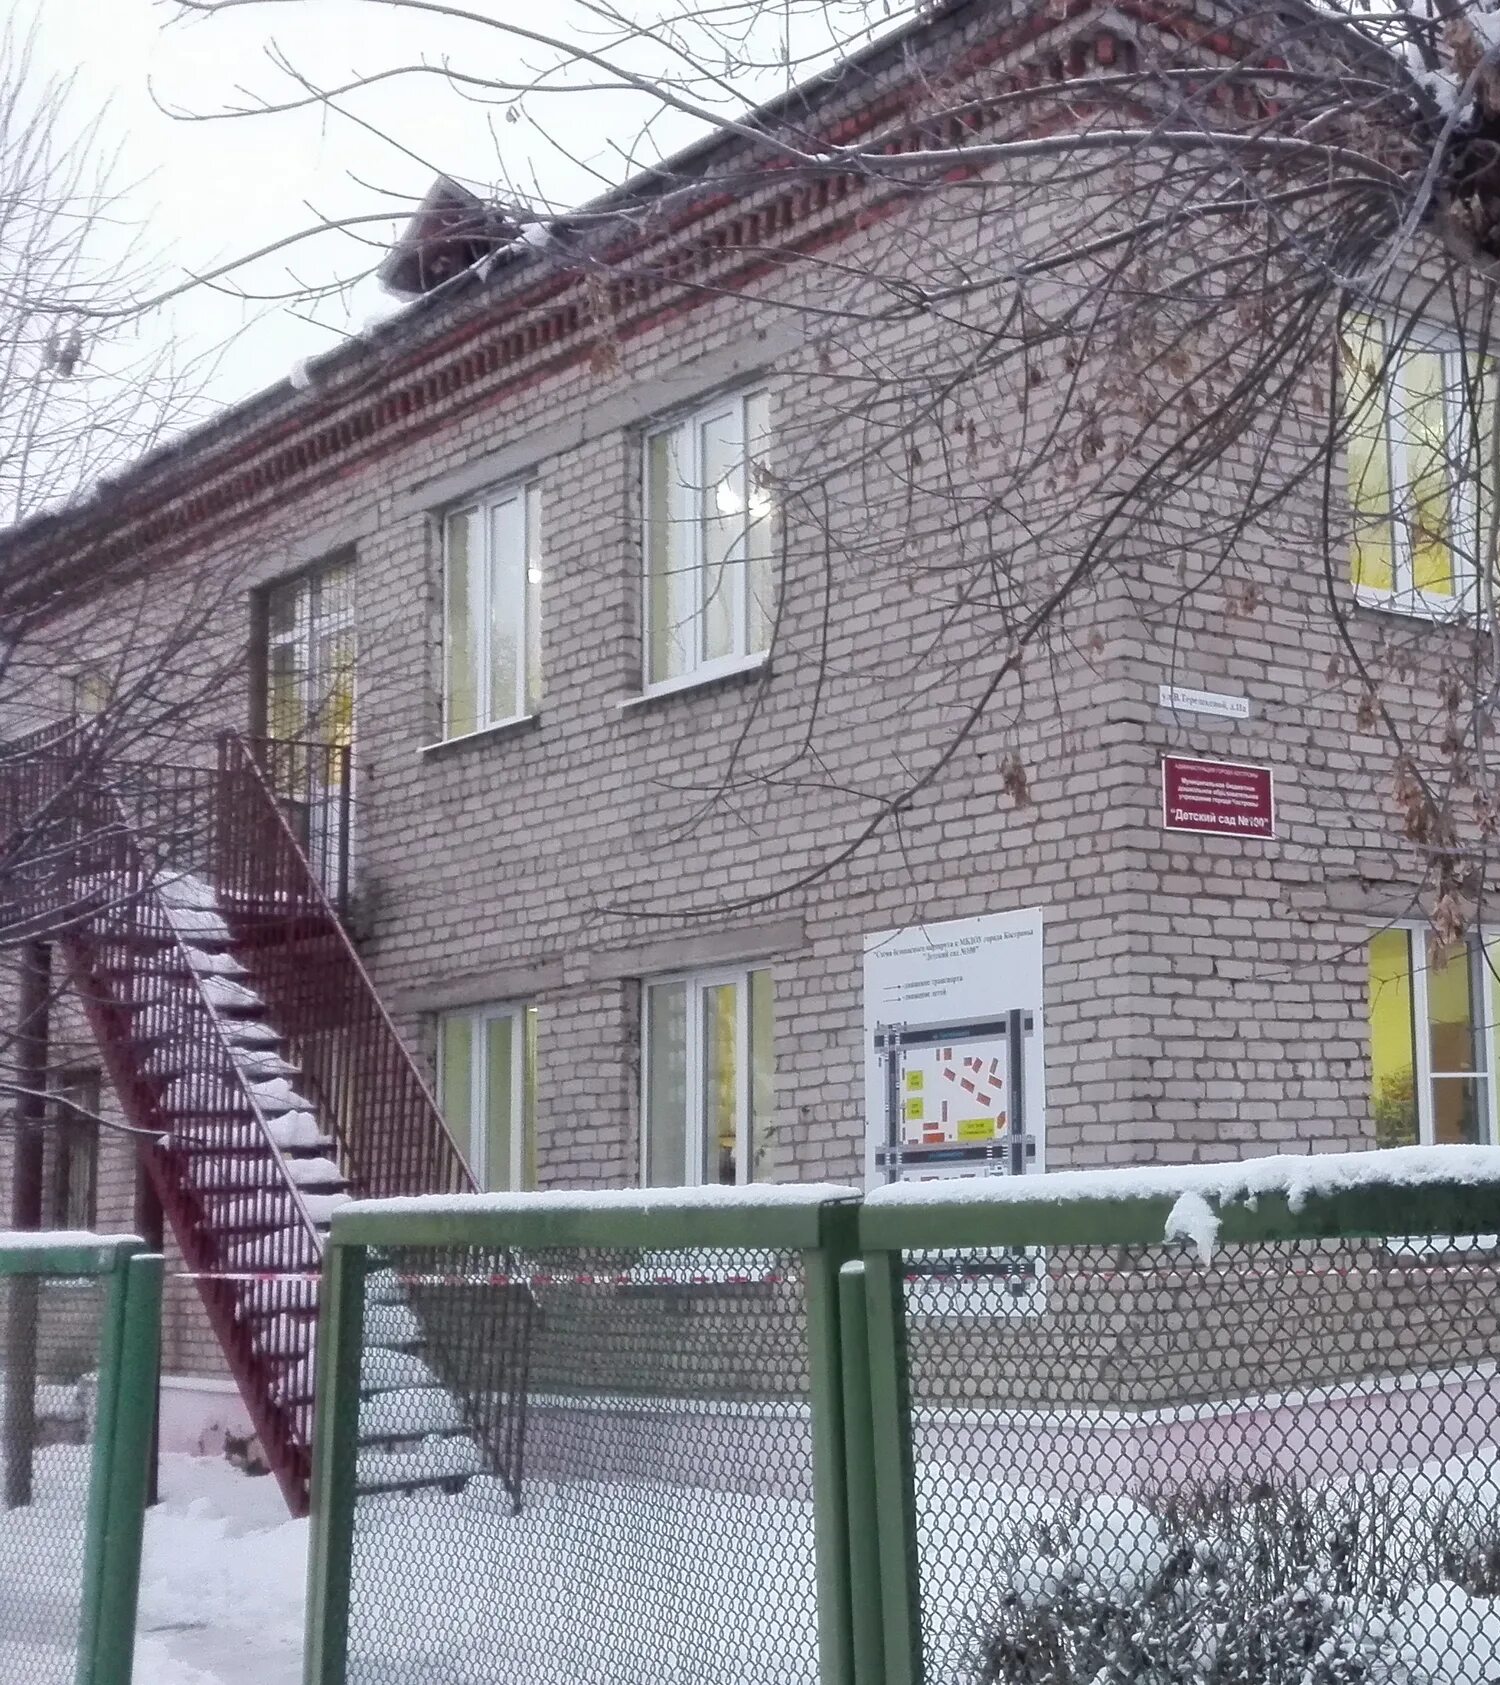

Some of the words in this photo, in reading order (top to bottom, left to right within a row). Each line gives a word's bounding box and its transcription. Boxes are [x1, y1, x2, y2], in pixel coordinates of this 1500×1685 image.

[1181, 777, 1225, 788] Муниципальное
[1170, 808, 1217, 824] "Детский
[1218, 815, 1236, 826] сад
